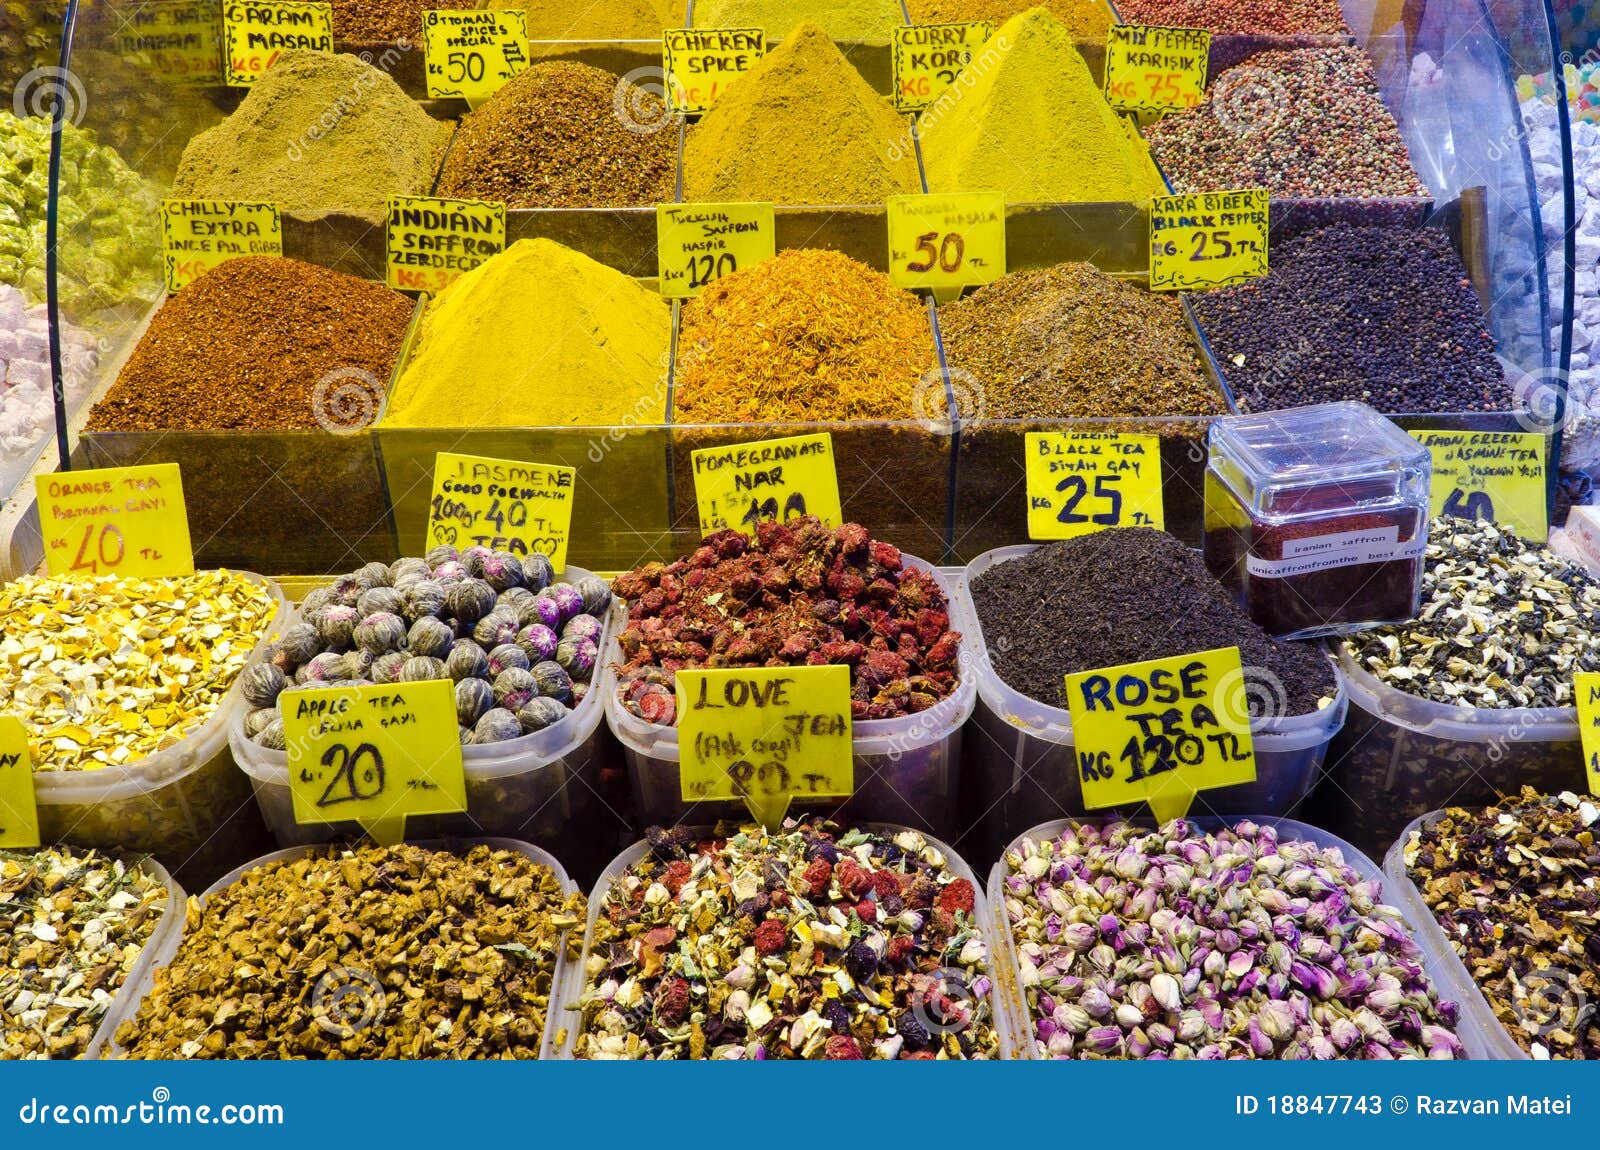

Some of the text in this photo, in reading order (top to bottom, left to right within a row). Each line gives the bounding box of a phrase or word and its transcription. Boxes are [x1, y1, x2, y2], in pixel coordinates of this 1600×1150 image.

[228, 5, 314, 26] GARAM
[247, 32, 331, 51] MASALA
[446, 35, 496, 47] SPECIAL
[460, 25, 508, 37] SPICES
[901, 26, 967, 45] CURRY
[1153, 31, 1209, 51] PEPPER
[671, 33, 763, 51] CHICKEN
[232, 57, 261, 73] KG
[447, 52, 485, 83] 50
[687, 55, 749, 73] SPICE
[901, 76, 930, 97] KG
[1110, 81, 1137, 98] KG
[1144, 73, 1182, 102] 75
[168, 201, 237, 216] CHILLY
[1152, 197, 1198, 214] KARA
[190, 220, 261, 237] EXTRA
[389, 208, 493, 234] INDIAN
[701, 221, 759, 237] SAFFRON
[1152, 210, 1268, 231] BLACK PEPPER
[403, 232, 502, 256] SAFFRON
[905, 231, 965, 274] 50
[176, 260, 207, 278] KG
[686, 252, 737, 288] 120
[1039, 439, 1146, 456] BLACK TEA
[1470, 433, 1524, 447] GREEN
[695, 441, 826, 475] POMEGRANATE
[1507, 448, 1539, 462] TEA
[48, 476, 161, 498] ORANGE TEA
[442, 479, 483, 495] GOOD
[734, 465, 785, 492] NAR
[1055, 474, 1123, 526] 25
[1130, 511, 1155, 525] TL
[484, 498, 528, 533] 40
[69, 523, 125, 574] 40
[139, 548, 164, 561] TL
[470, 535, 529, 555] TEA
[1294, 534, 1386, 553] iranian saffron
[1367, 550, 1395, 560] best
[694, 676, 796, 710] LOVE
[1079, 661, 1208, 712] ROSE
[296, 693, 406, 719] APPLE TEA
[1125, 703, 1219, 739] TEA
[1079, 750, 1115, 783] KG
[1119, 733, 1205, 784] 120
[316, 742, 384, 808] 20
